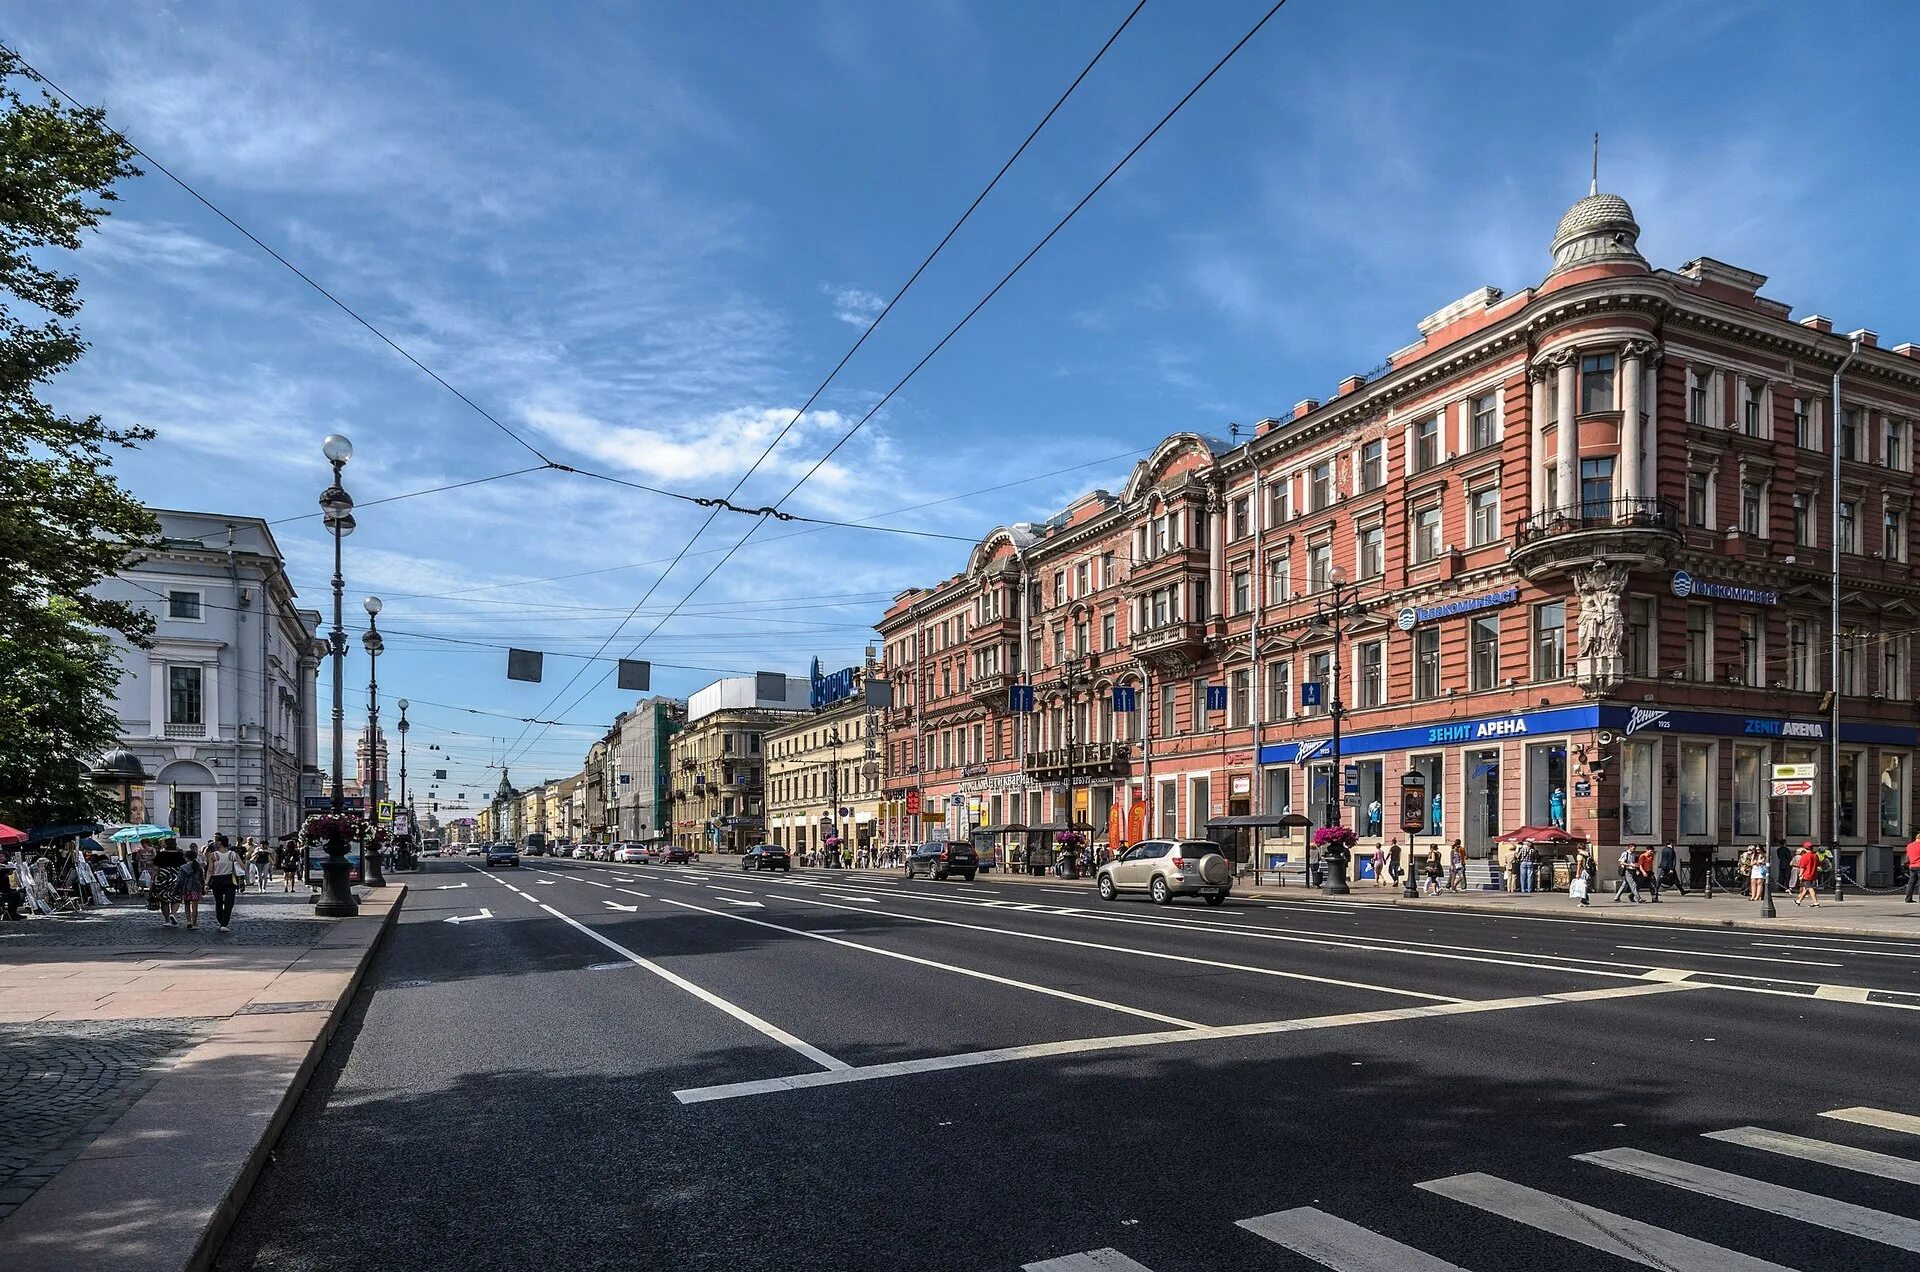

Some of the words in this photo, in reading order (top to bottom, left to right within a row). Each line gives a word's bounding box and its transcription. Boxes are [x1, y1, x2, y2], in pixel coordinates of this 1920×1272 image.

[1428, 724, 1471, 743] ЗЕНИТ
[1477, 718, 1527, 737] АРЕНА
[1658, 720, 1671, 728] 1925
[1744, 719, 1780, 734] ZENIT
[1782, 722, 1823, 737] ARENA
